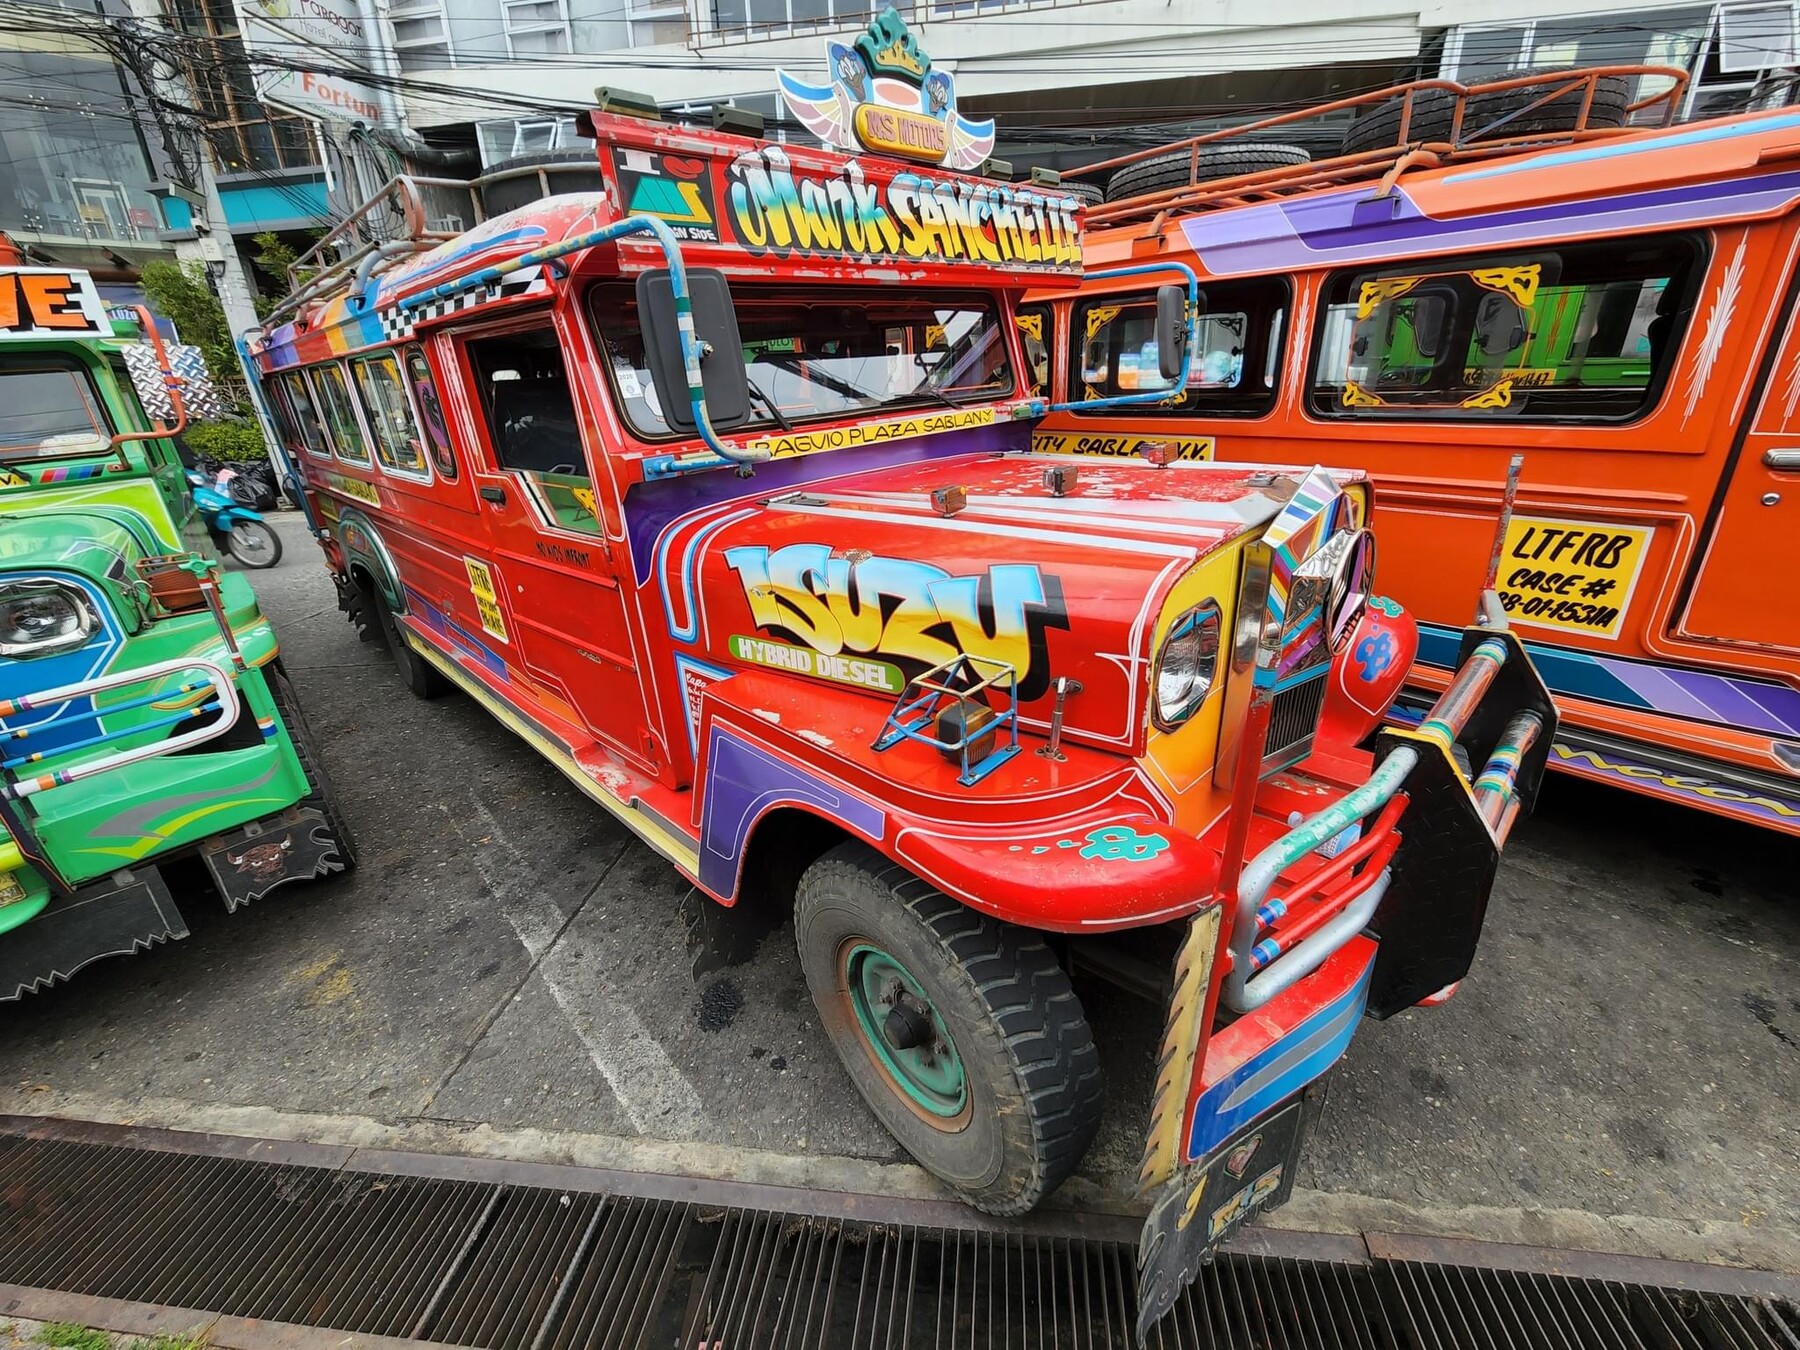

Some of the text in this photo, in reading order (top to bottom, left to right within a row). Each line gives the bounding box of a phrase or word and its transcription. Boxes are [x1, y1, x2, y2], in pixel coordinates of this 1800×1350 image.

[302, 71, 379, 121] Fortun
[898, 117, 945, 152] MOTORS
[730, 146, 901, 255] Mark
[849, 422, 917, 445] PLAZA
[1073, 438, 1150, 457] SABLA
[1512, 527, 1633, 569] LTFRB
[1507, 568, 1585, 596] CASE
[722, 542, 1050, 690] ISUZU
[738, 637, 893, 691] HYBRID DIESEL
